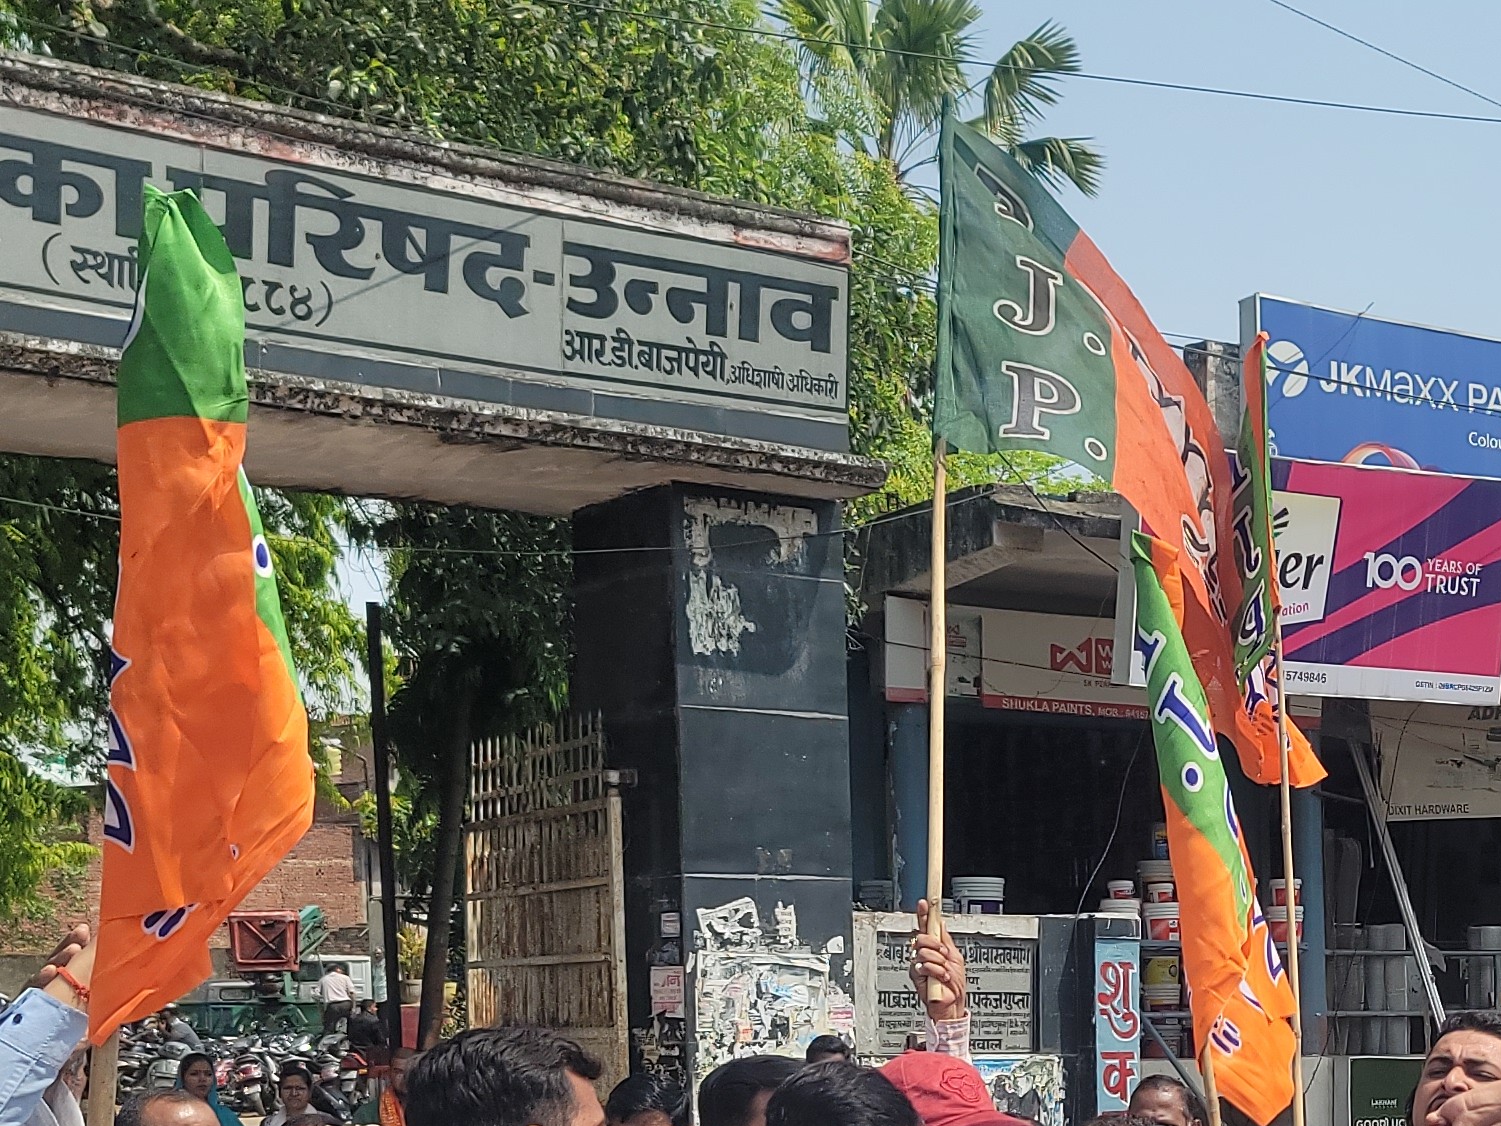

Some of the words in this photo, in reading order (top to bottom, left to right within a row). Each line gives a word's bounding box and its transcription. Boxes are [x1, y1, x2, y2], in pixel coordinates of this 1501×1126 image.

[786, 370, 839, 400] अधिकारी
[1363, 551, 1423, 591] 100
[1426, 558, 1463, 574] YEARS
[1466, 563, 1483, 576] OF
[1425, 573, 1481, 598] TRUST
[1281, 602, 1309, 617] ation
[1002, 698, 1050, 712] SHUKLA
[1387, 804, 1412, 816] DIXIT
[1414, 803, 1470, 815] HARDWARE
